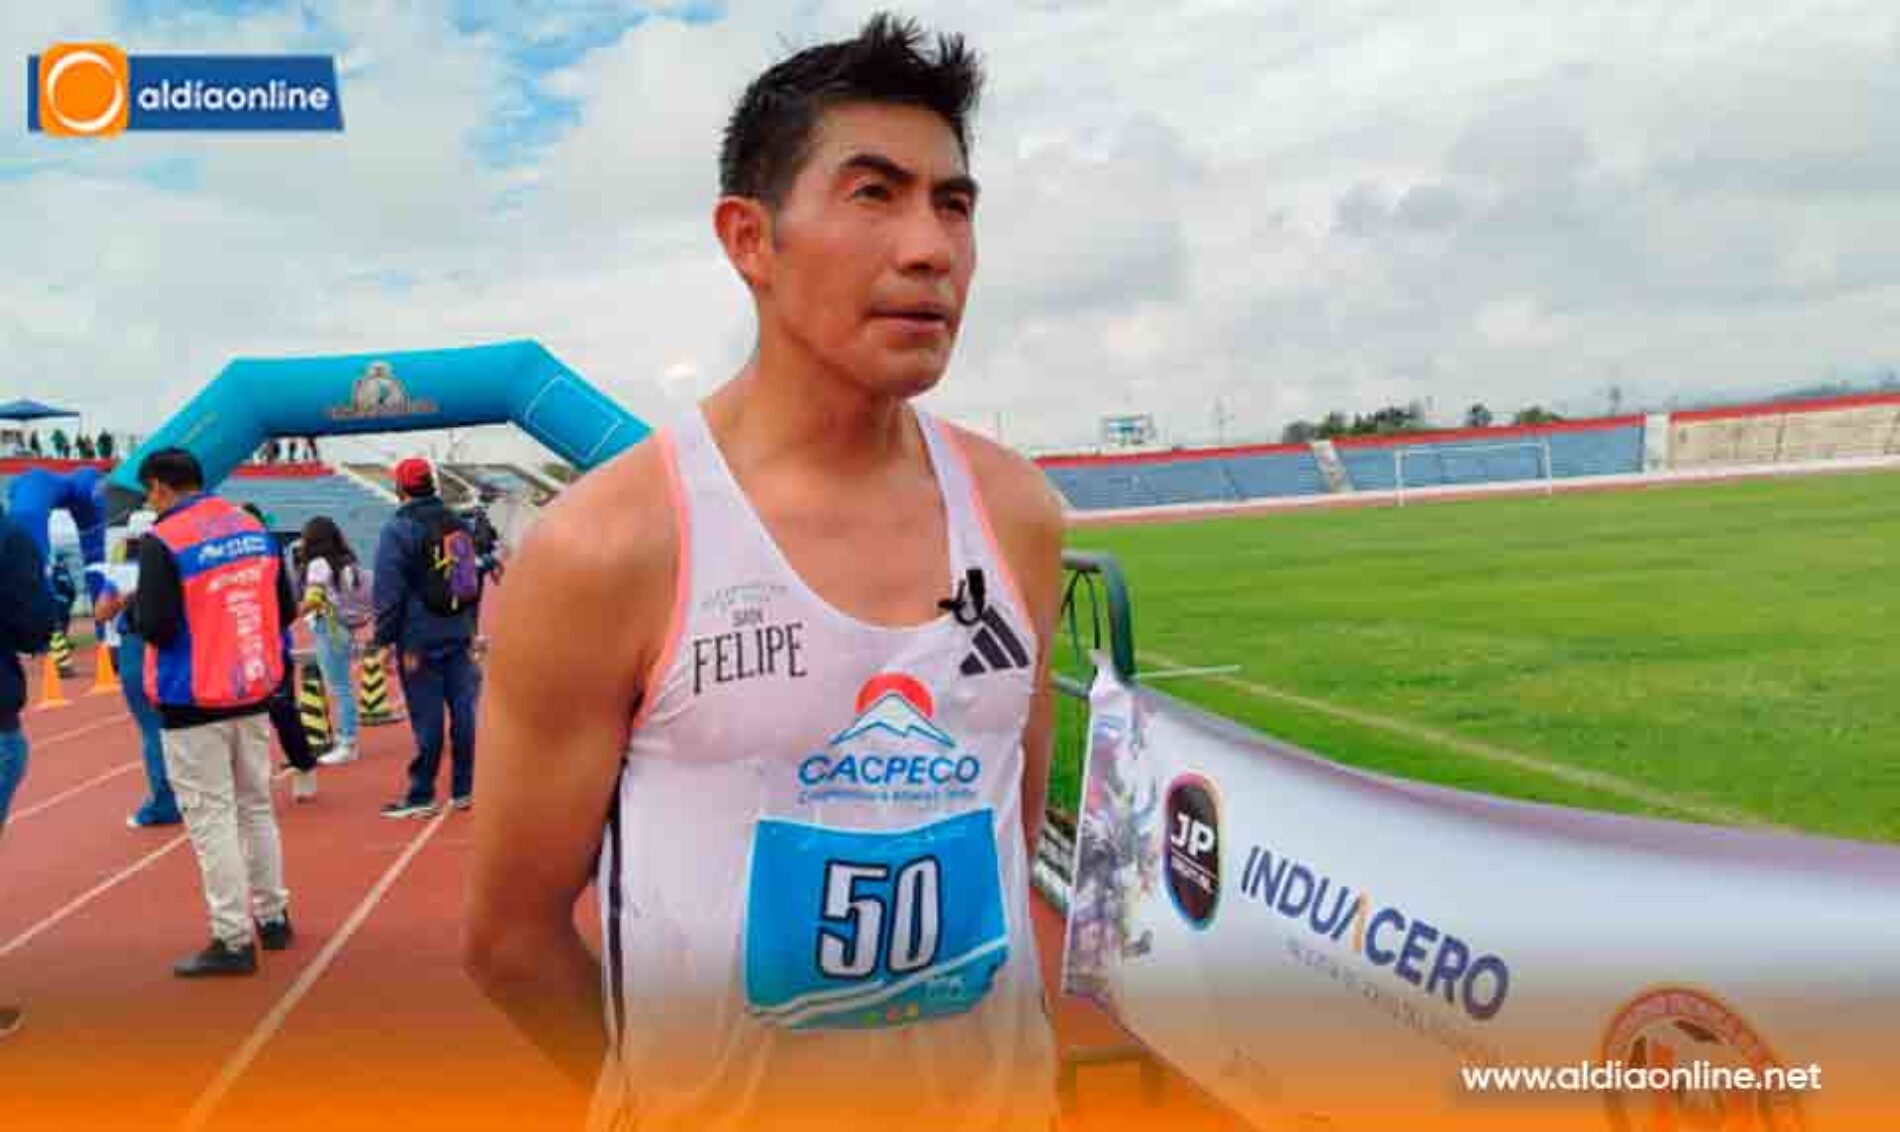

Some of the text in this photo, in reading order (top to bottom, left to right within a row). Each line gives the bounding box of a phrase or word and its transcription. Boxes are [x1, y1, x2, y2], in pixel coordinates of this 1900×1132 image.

[694, 622, 807, 694] FELIPE
[798, 753, 980, 785] CACPECO
[1171, 811, 1215, 856] JP
[816, 855, 942, 980] 50
[1240, 845, 1509, 1021] INDUACERO
